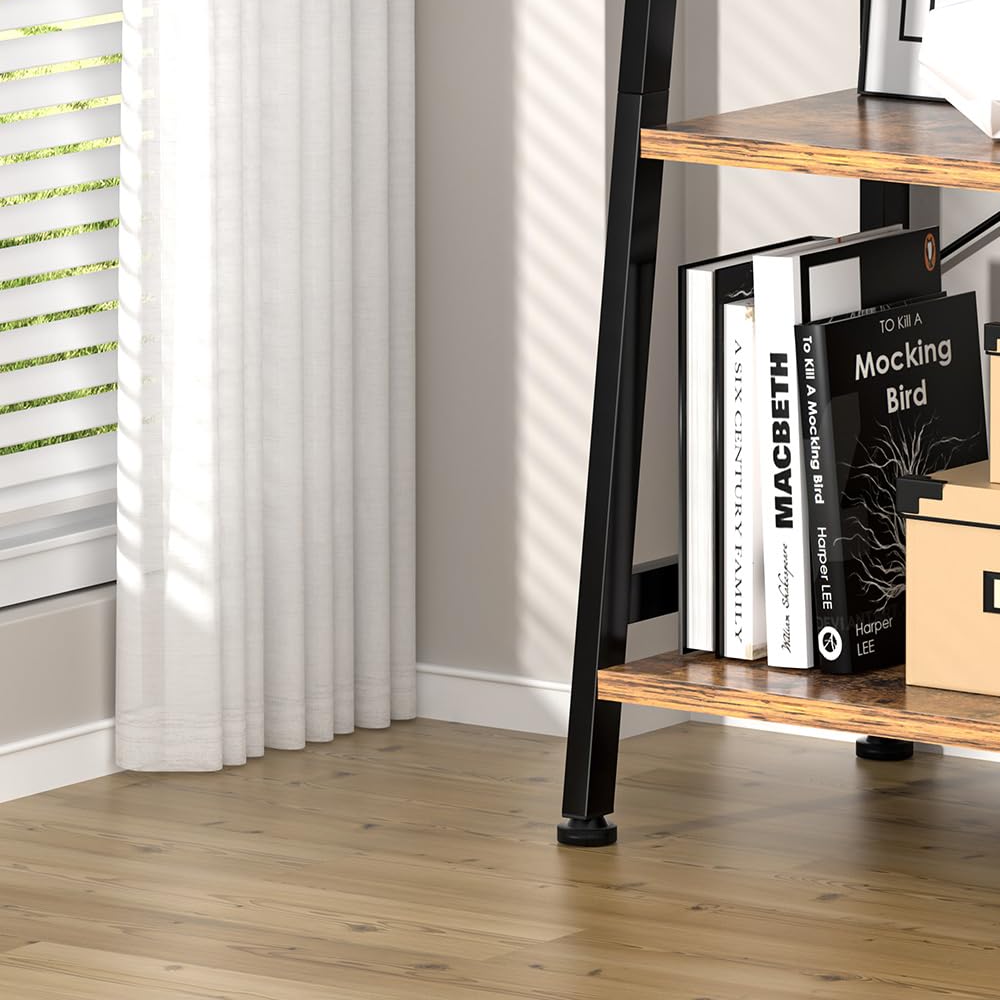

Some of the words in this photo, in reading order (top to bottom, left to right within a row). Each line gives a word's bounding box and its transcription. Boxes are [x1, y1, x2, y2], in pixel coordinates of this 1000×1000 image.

[880, 318, 895, 334] TO
[897, 313, 912, 330] Kill
[913, 312, 923, 326] A
[734, 339, 743, 355] A
[802, 335, 813, 353] To
[804, 358, 816, 380] Kill
[855, 338, 952, 381] Mocking
[734, 361, 743, 403] SIX
[806, 384, 817, 397] A
[886, 378, 928, 414] Bird
[769, 352, 794, 529] MACBETH
[808, 400, 821, 470] Mocking
[734, 410, 743, 537] CENTURY
[813, 474, 825, 504] Bird
[816, 526, 829, 581] Harper
[734, 544, 743, 643] FAMILY
[821, 584, 833, 610] LEE
[855, 616, 894, 637] Harper
[856, 638, 876, 657] LEE
